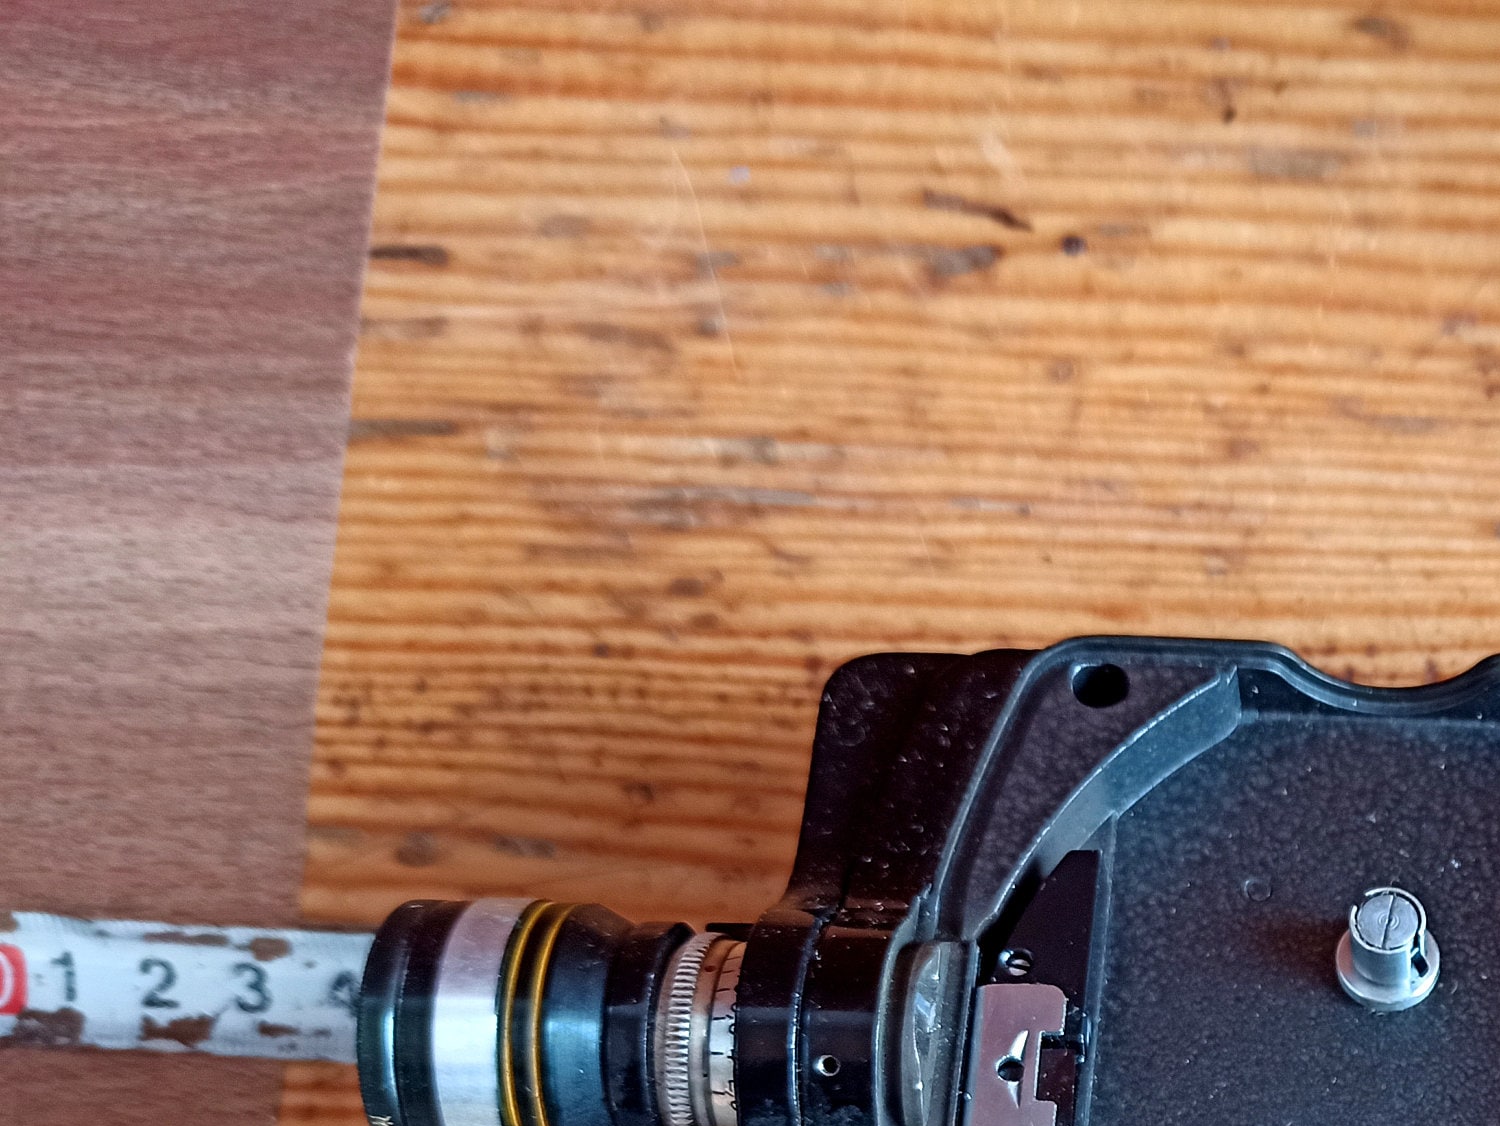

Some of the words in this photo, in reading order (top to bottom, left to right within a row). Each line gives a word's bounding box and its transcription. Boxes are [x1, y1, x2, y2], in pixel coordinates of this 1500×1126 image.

[50, 951, 77, 1001] 1
[139, 957, 181, 1009] 2
[232, 961, 273, 1013] 3
